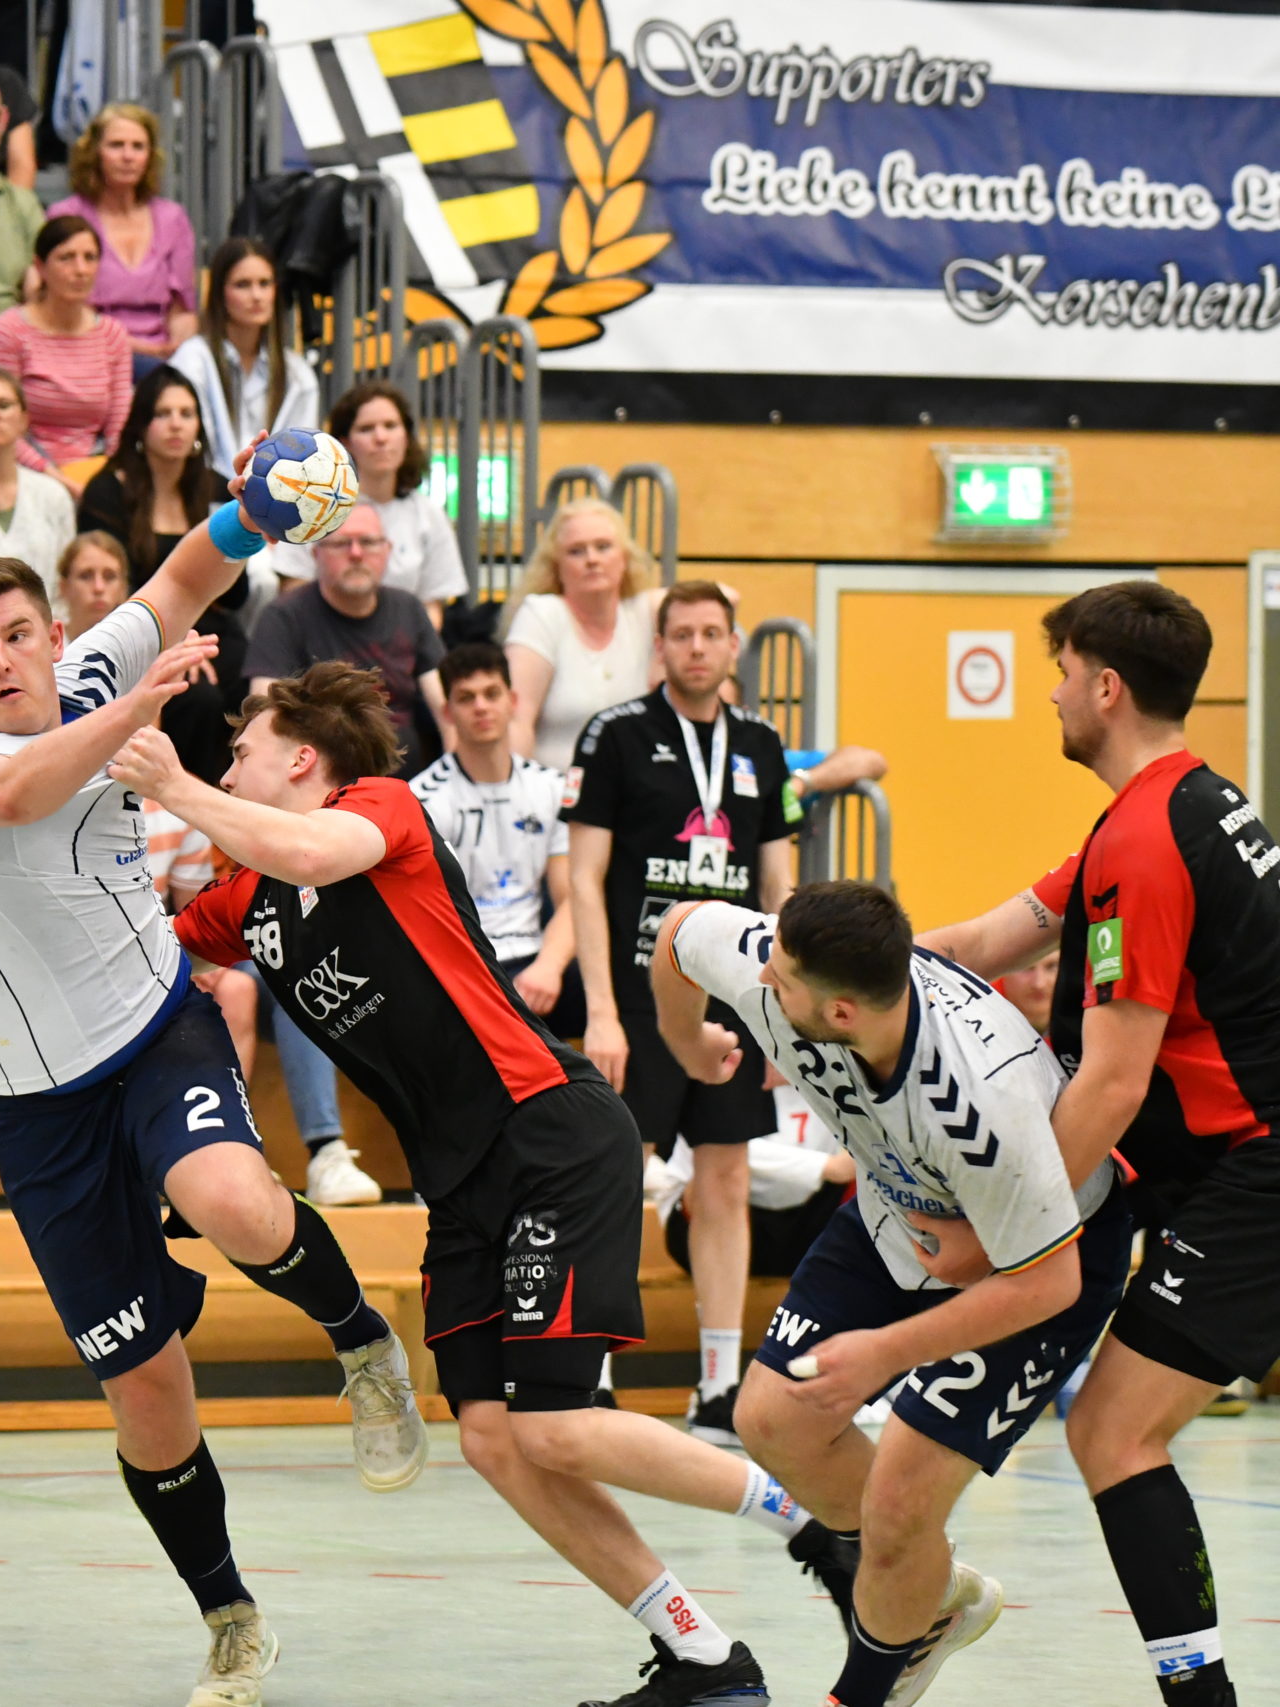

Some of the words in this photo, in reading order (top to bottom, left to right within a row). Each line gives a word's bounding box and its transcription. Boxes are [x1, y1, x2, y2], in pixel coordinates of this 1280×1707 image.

[633, 18, 992, 127] Supporters
[703, 144, 875, 217] Liebe
[878, 150, 1054, 225] kennt
[1057, 158, 1220, 230] keine
[645, 857, 750, 891] ENLS
[699, 853, 716, 873] A
[294, 945, 370, 1020] G&K
[335, 1021, 347, 1034] &
[340, 992, 386, 1029] Kollegen
[183, 1085, 225, 1132] 2
[789, 1111, 810, 1144] 7
[512, 1311, 545, 1322] erima
[157, 1465, 198, 1491] SELECT
[665, 1595, 700, 1637] HSG
